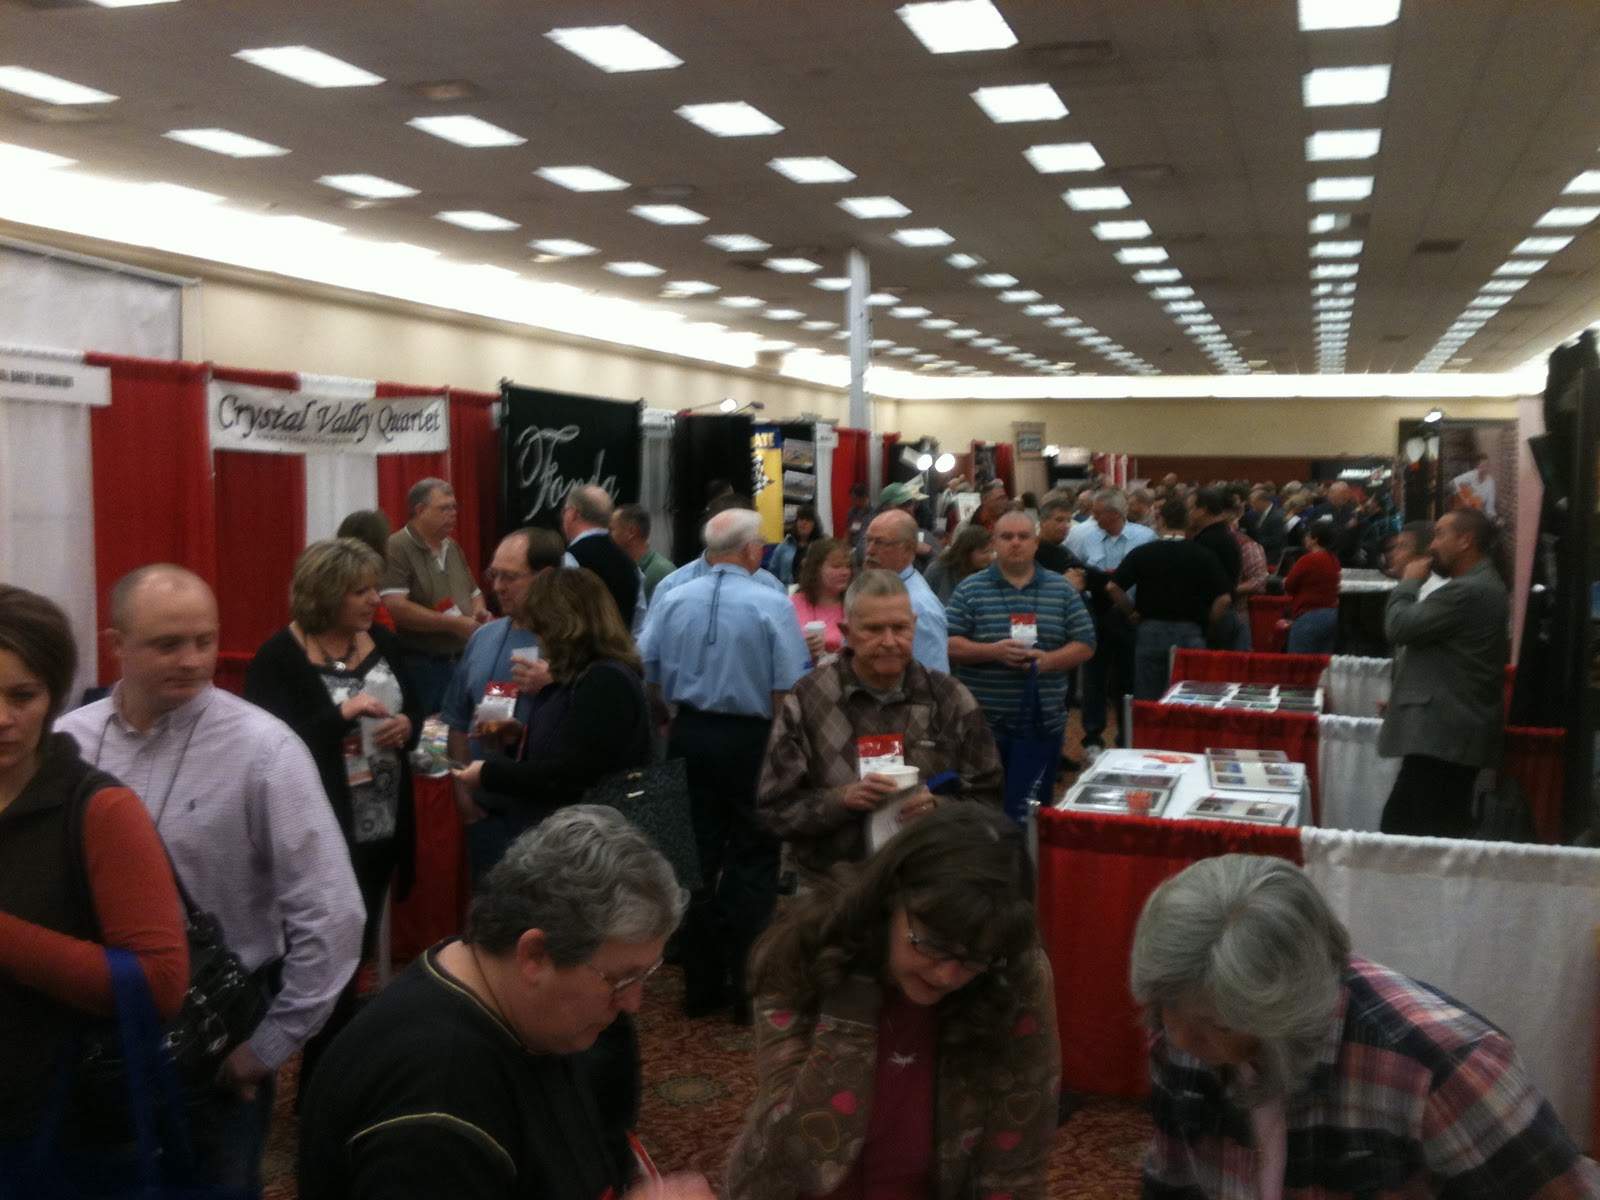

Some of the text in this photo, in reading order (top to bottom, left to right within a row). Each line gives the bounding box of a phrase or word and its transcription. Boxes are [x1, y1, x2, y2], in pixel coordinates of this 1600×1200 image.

[218, 394, 440, 443] Crystal Valley Quartet
